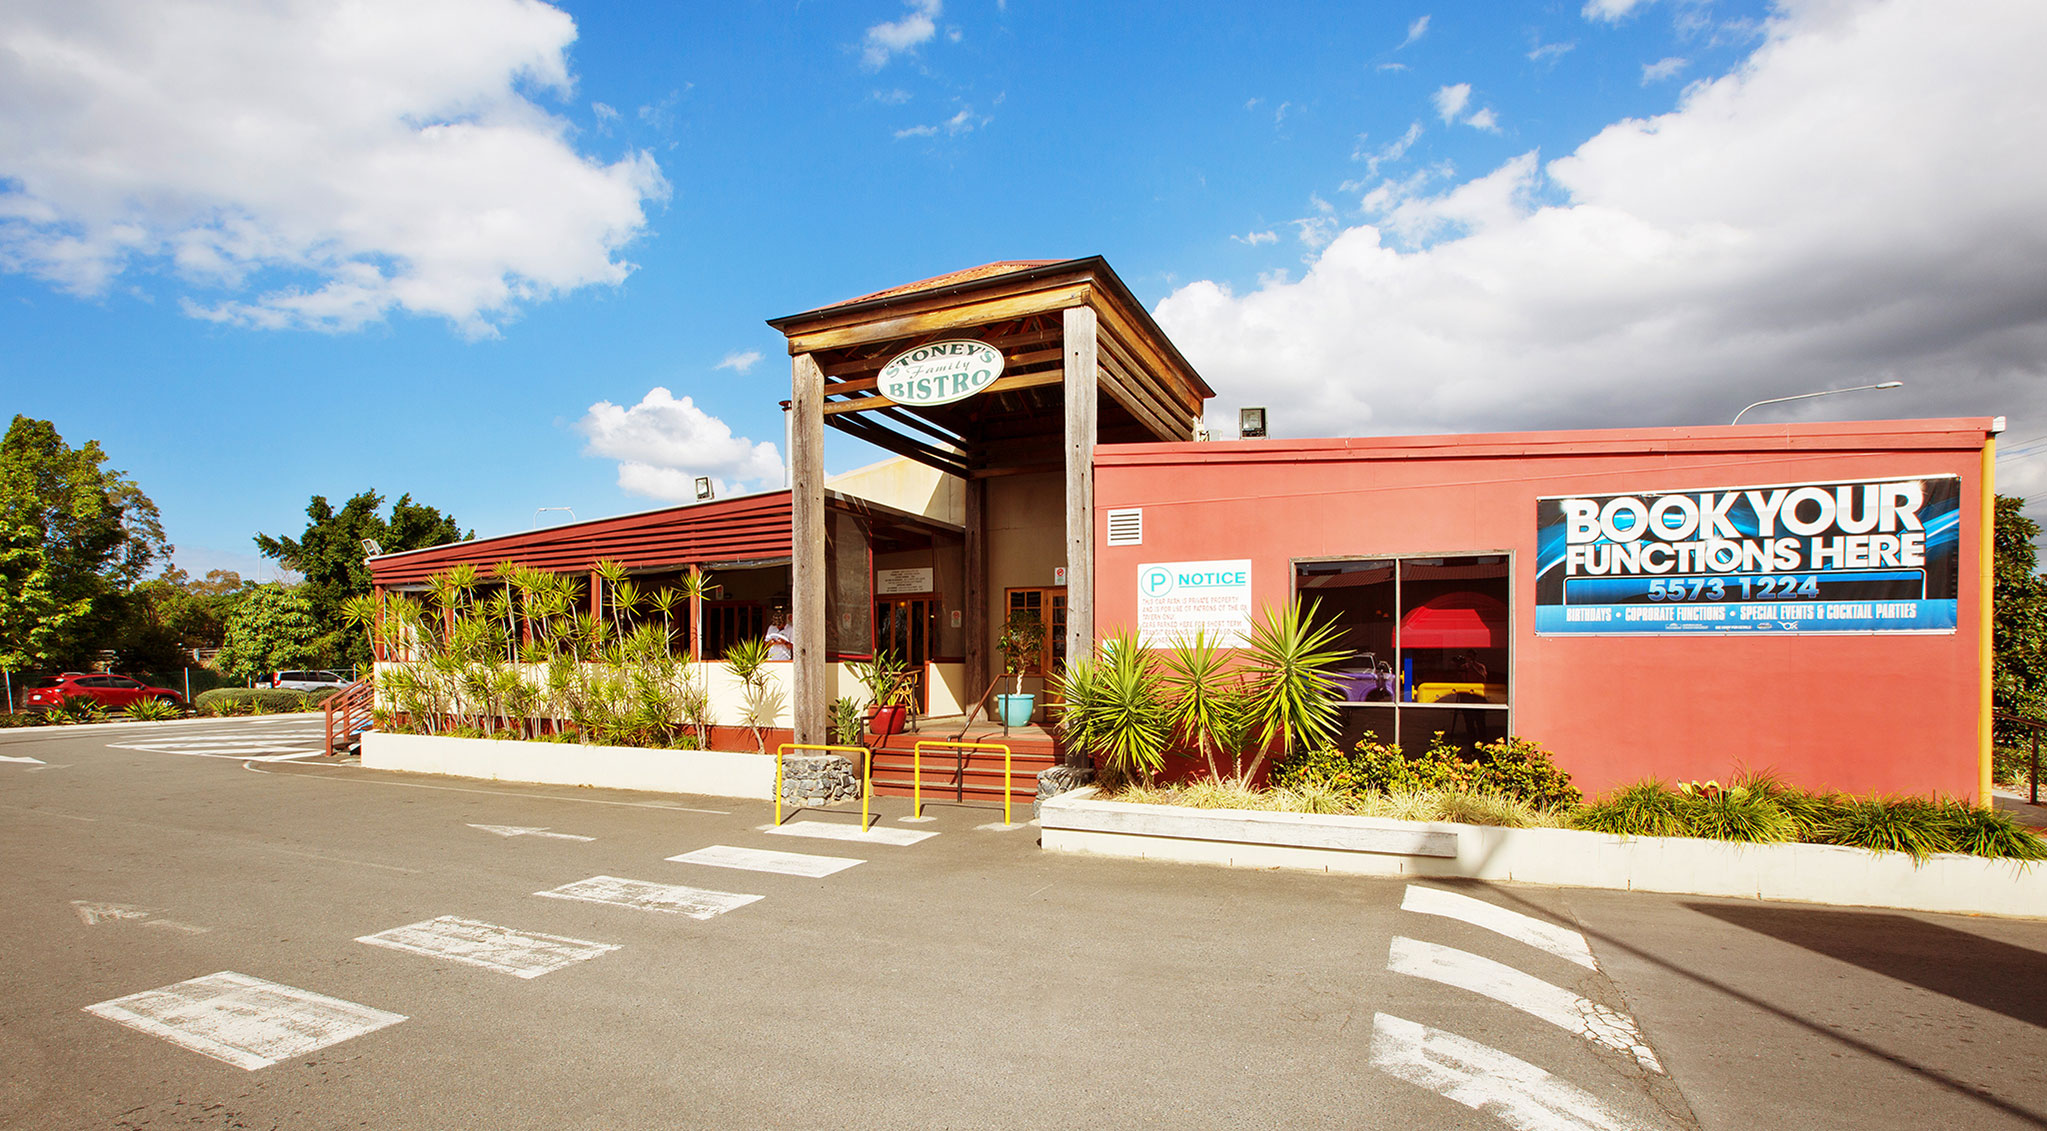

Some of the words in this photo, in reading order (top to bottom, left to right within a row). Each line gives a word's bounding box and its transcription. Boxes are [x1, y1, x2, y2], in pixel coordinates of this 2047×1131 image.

[886, 344, 996, 378] STONEY'S
[907, 361, 970, 379] Family
[889, 369, 991, 400] BISTRO
[1565, 491, 1743, 543] BOOK
[1745, 481, 1925, 537] YOUR
[1566, 537, 1801, 575] FUNCTIONS
[1811, 532, 1926, 569] HERE
[1151, 573, 1166, 592] P
[1178, 571, 1246, 586] NOTICE
[1648, 577, 1726, 601] 5573
[1738, 575, 1819, 600] 1224
[1566, 607, 1612, 622] BIRTHDAYS
[1677, 606, 1726, 621] FUNCTIONS
[1740, 605, 1778, 620] SPECIAL
[1781, 605, 1815, 620] EVENTS
[1817, 604, 1825, 620] &
[1827, 604, 1873, 619] COCKTAIL
[1876, 603, 1917, 619] PARTIES
